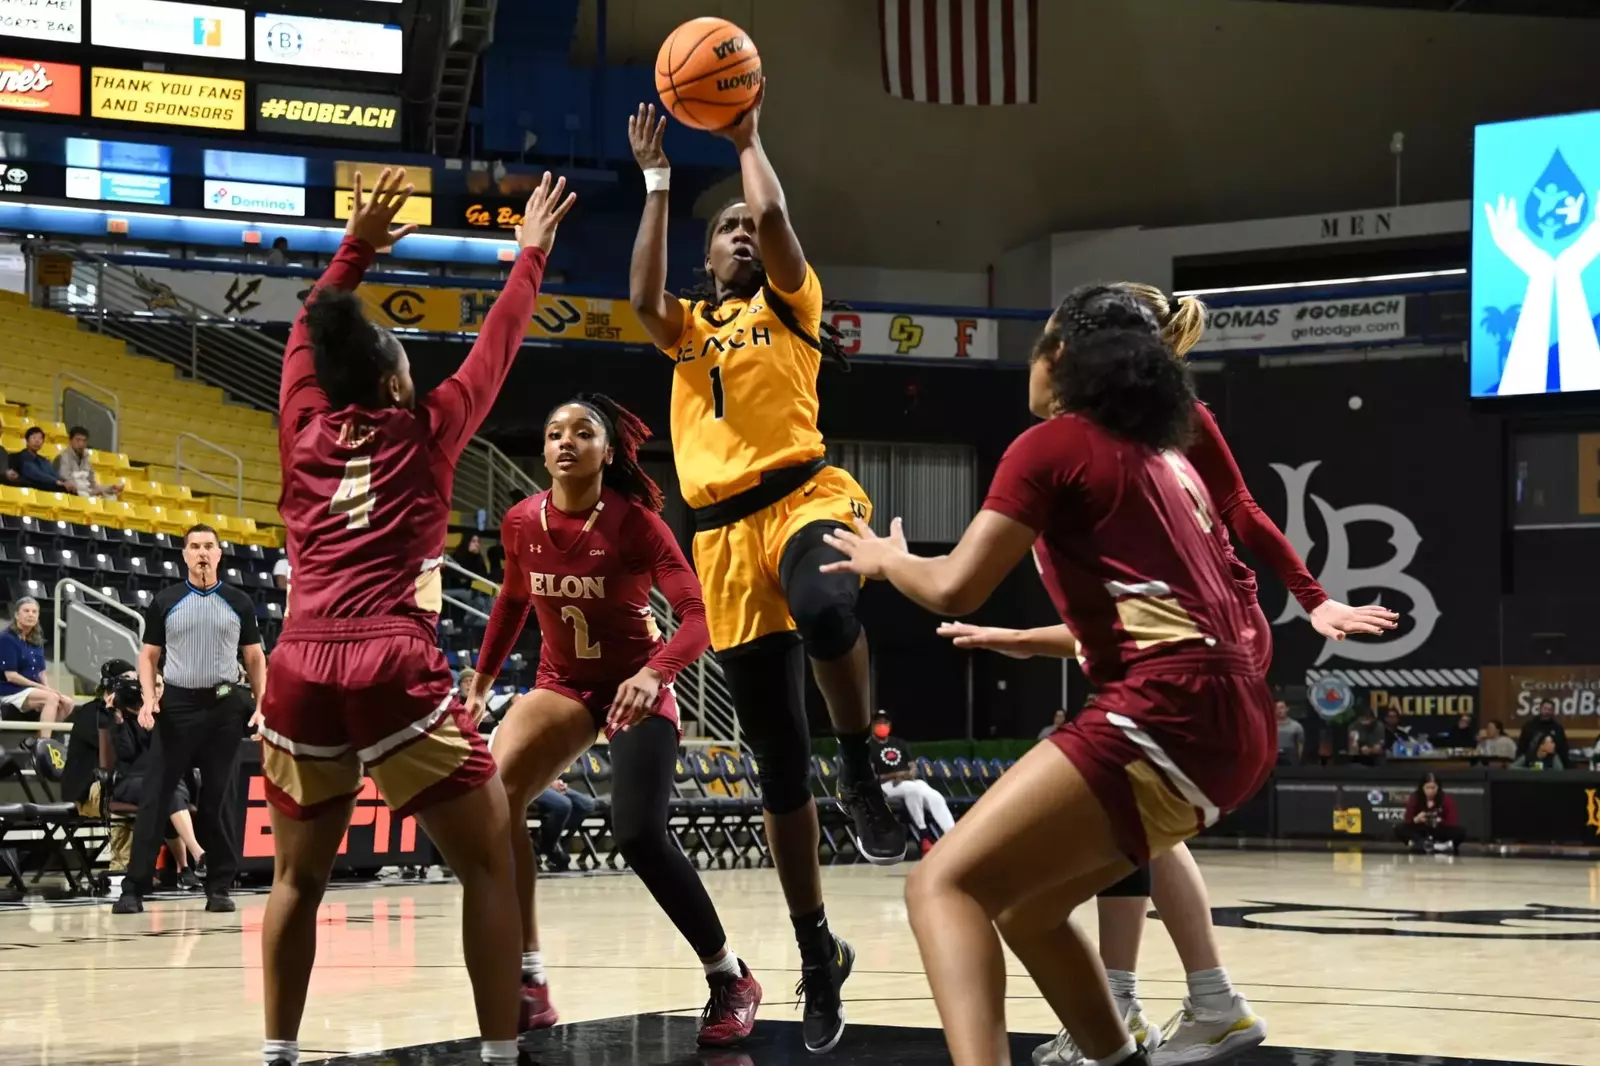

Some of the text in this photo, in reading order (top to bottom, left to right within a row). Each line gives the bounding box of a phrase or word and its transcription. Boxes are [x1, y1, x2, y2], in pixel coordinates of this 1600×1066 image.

[47, 21, 76, 34] BAR
[94, 75, 243, 101] THANK YOU FANS
[101, 97, 234, 121] AND SPONSORS
[260, 98, 397, 129] #GOBEACH
[231, 195, 295, 211] Domino's
[465, 204, 490, 226] Go
[1320, 213, 1393, 239] MEN
[585, 312, 611, 326] BIG
[1294, 301, 1400, 321] #GOBEACH
[585, 326, 623, 340] WEST
[955, 319, 978, 357] F
[1292, 321, 1400, 341] getdodge.com
[709, 366, 724, 419] 1
[329, 455, 377, 530] 4
[529, 571, 605, 599] ELON
[561, 605, 601, 659] 2
